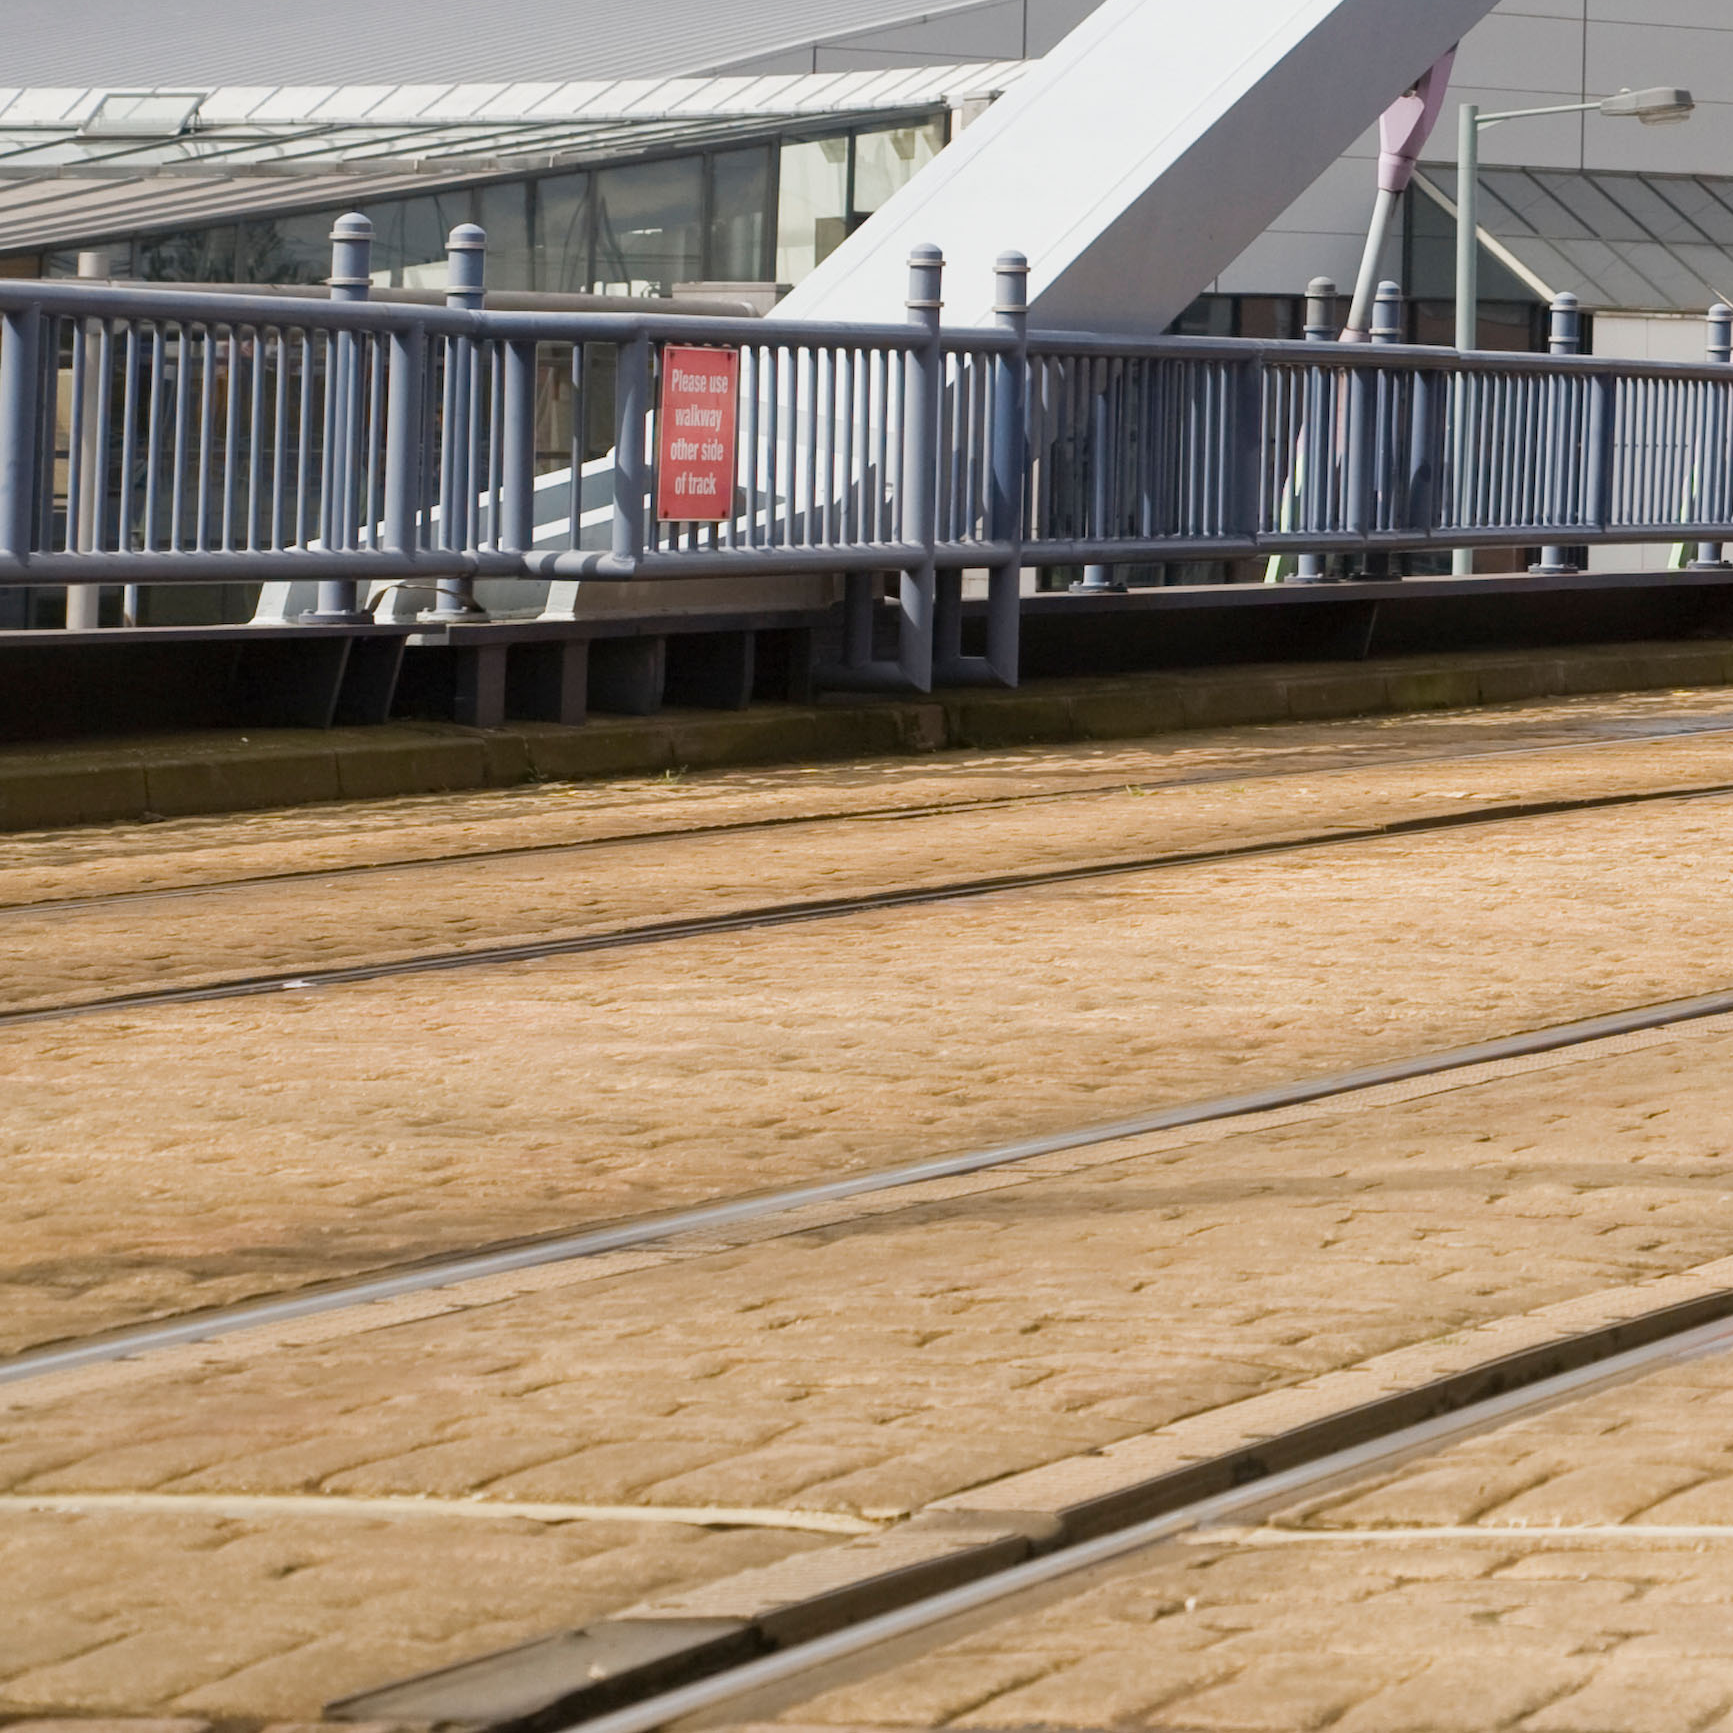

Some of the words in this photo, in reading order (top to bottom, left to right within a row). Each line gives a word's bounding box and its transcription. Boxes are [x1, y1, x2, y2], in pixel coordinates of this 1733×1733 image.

[671, 368, 707, 393] Please
[709, 375, 728, 394] use
[675, 404, 722, 432] walkway
[670, 438, 698, 461] other
[701, 438, 724, 461] side
[675, 472, 688, 495] of
[688, 472, 716, 495] track
